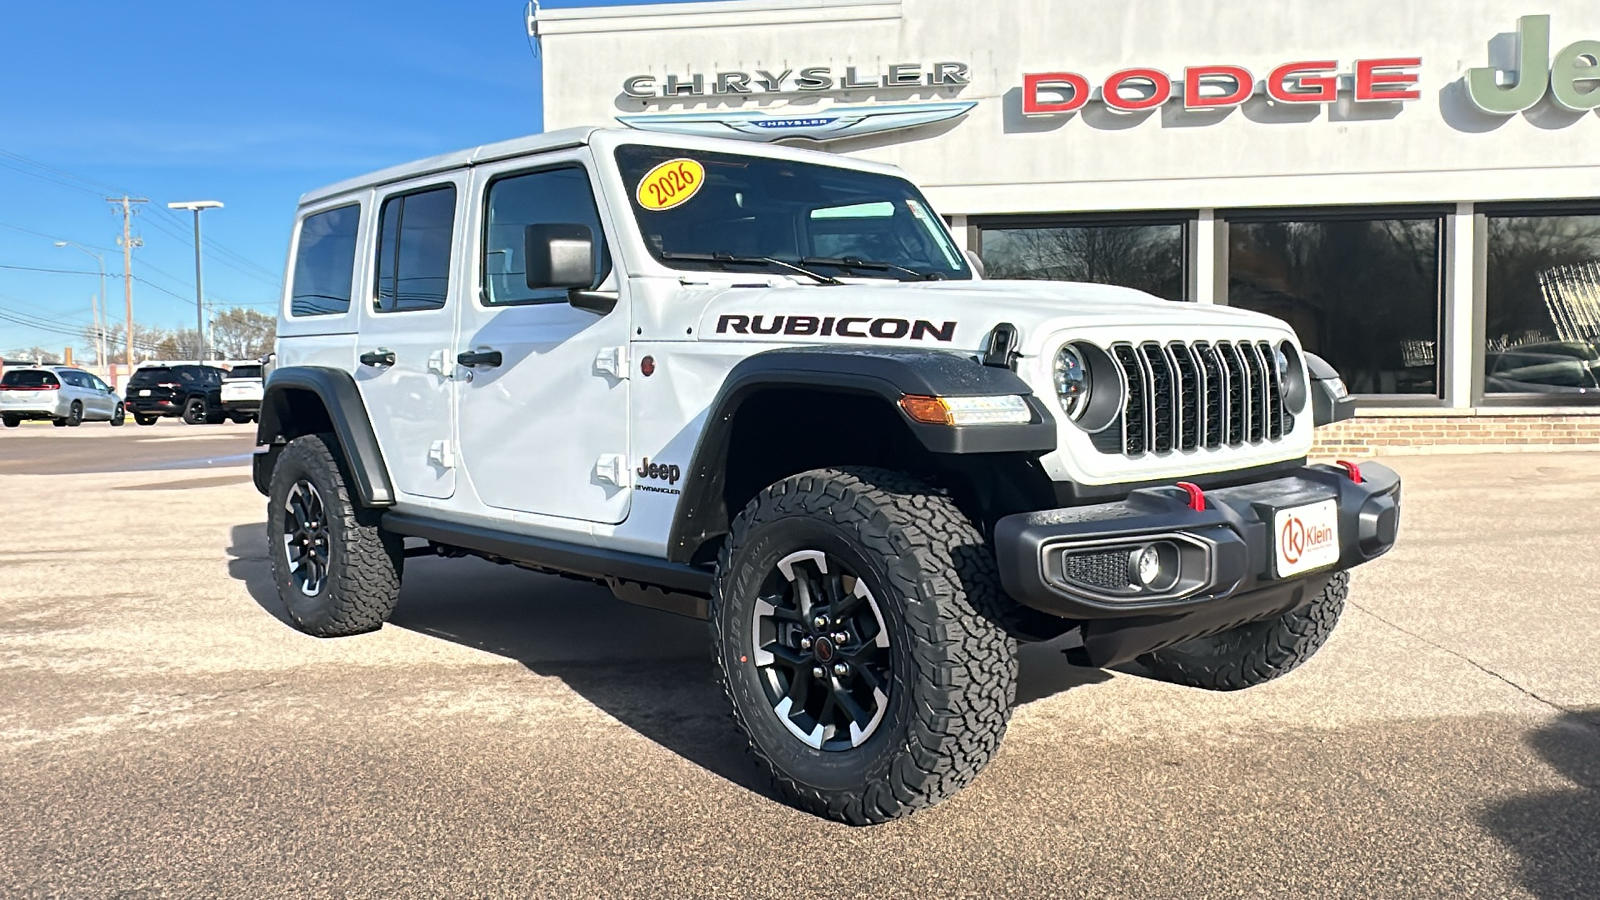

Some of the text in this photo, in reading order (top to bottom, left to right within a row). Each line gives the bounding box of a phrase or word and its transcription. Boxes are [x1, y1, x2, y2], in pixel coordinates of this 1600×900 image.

[623, 61, 971, 97] CHRYSLER
[1022, 57, 1422, 114] DODGE
[757, 118, 828, 127] CHRYSLER
[648, 163, 694, 206] 2026
[716, 314, 957, 342] RUBICON
[637, 456, 680, 485] Jeep
[642, 485, 680, 495] WRANGLER
[1307, 523, 1332, 547] Klein
